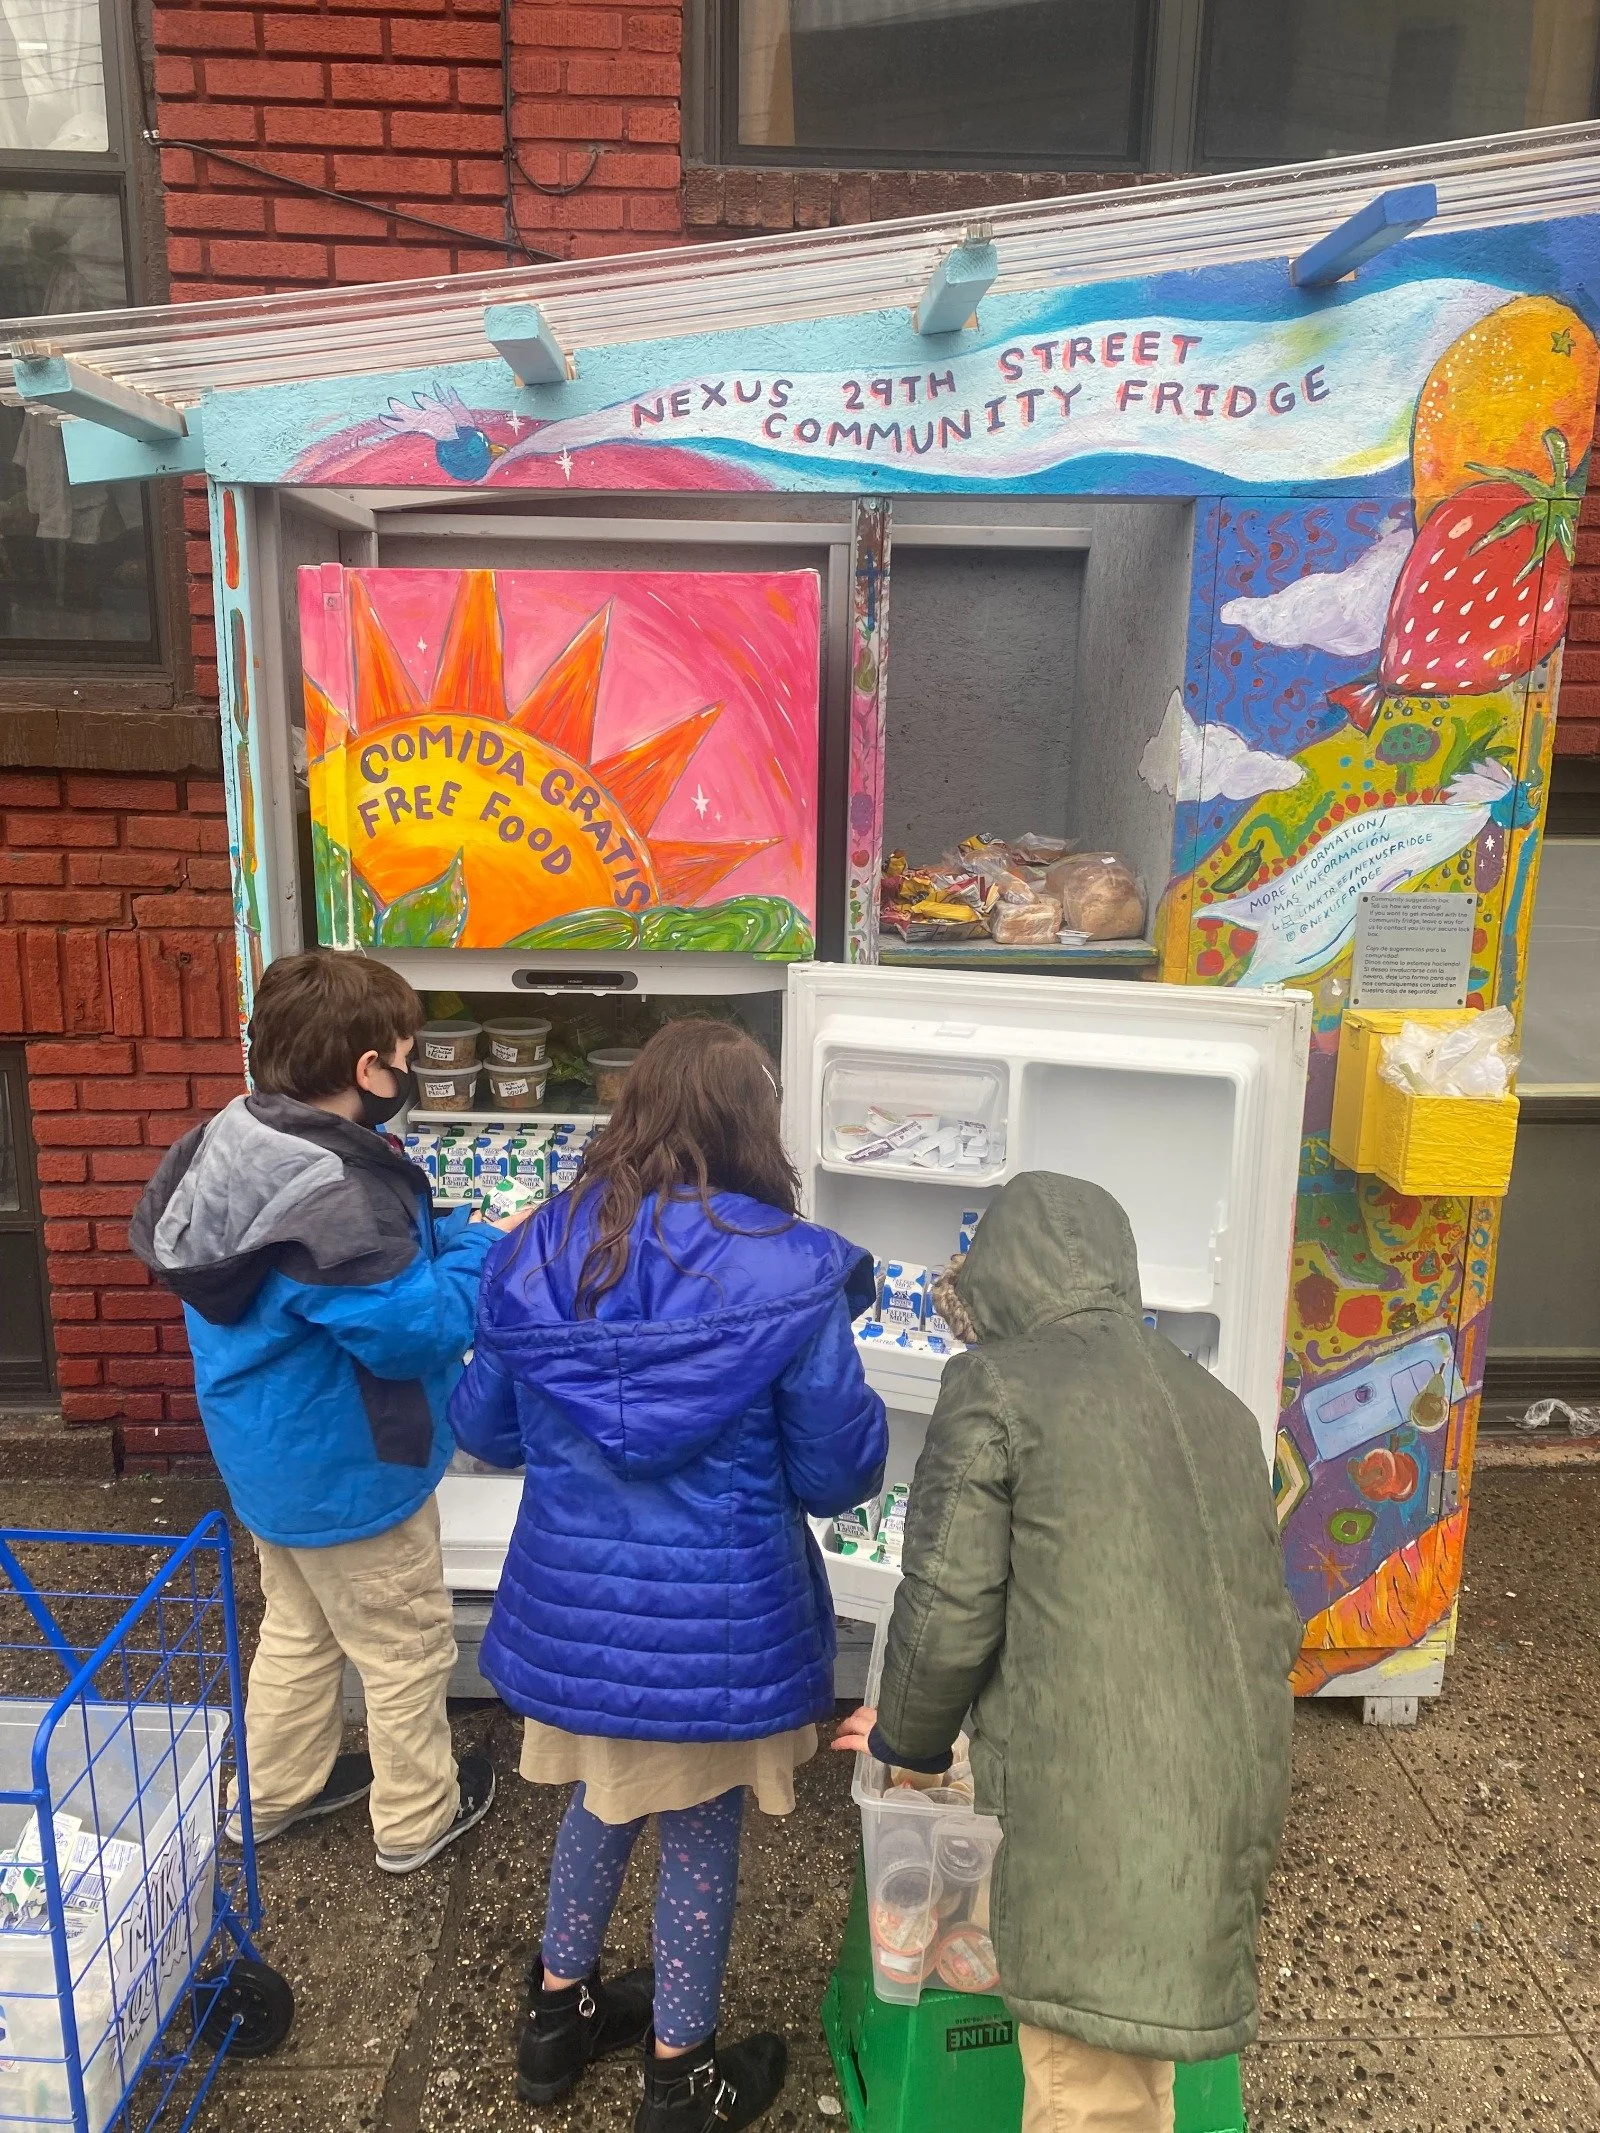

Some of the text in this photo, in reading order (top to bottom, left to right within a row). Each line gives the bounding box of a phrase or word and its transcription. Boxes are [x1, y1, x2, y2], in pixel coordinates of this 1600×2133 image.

[631, 331, 1202, 430] NEXUS 29TH STREET
[762, 365, 1330, 456] COMMUNITY FRIDGE
[357, 781, 572, 875] FREE FOOD
[360, 725, 651, 908] COMIDA GRATIS
[1250, 884, 1287, 914] MORE
[950, 2027, 1009, 2048] ULINE
